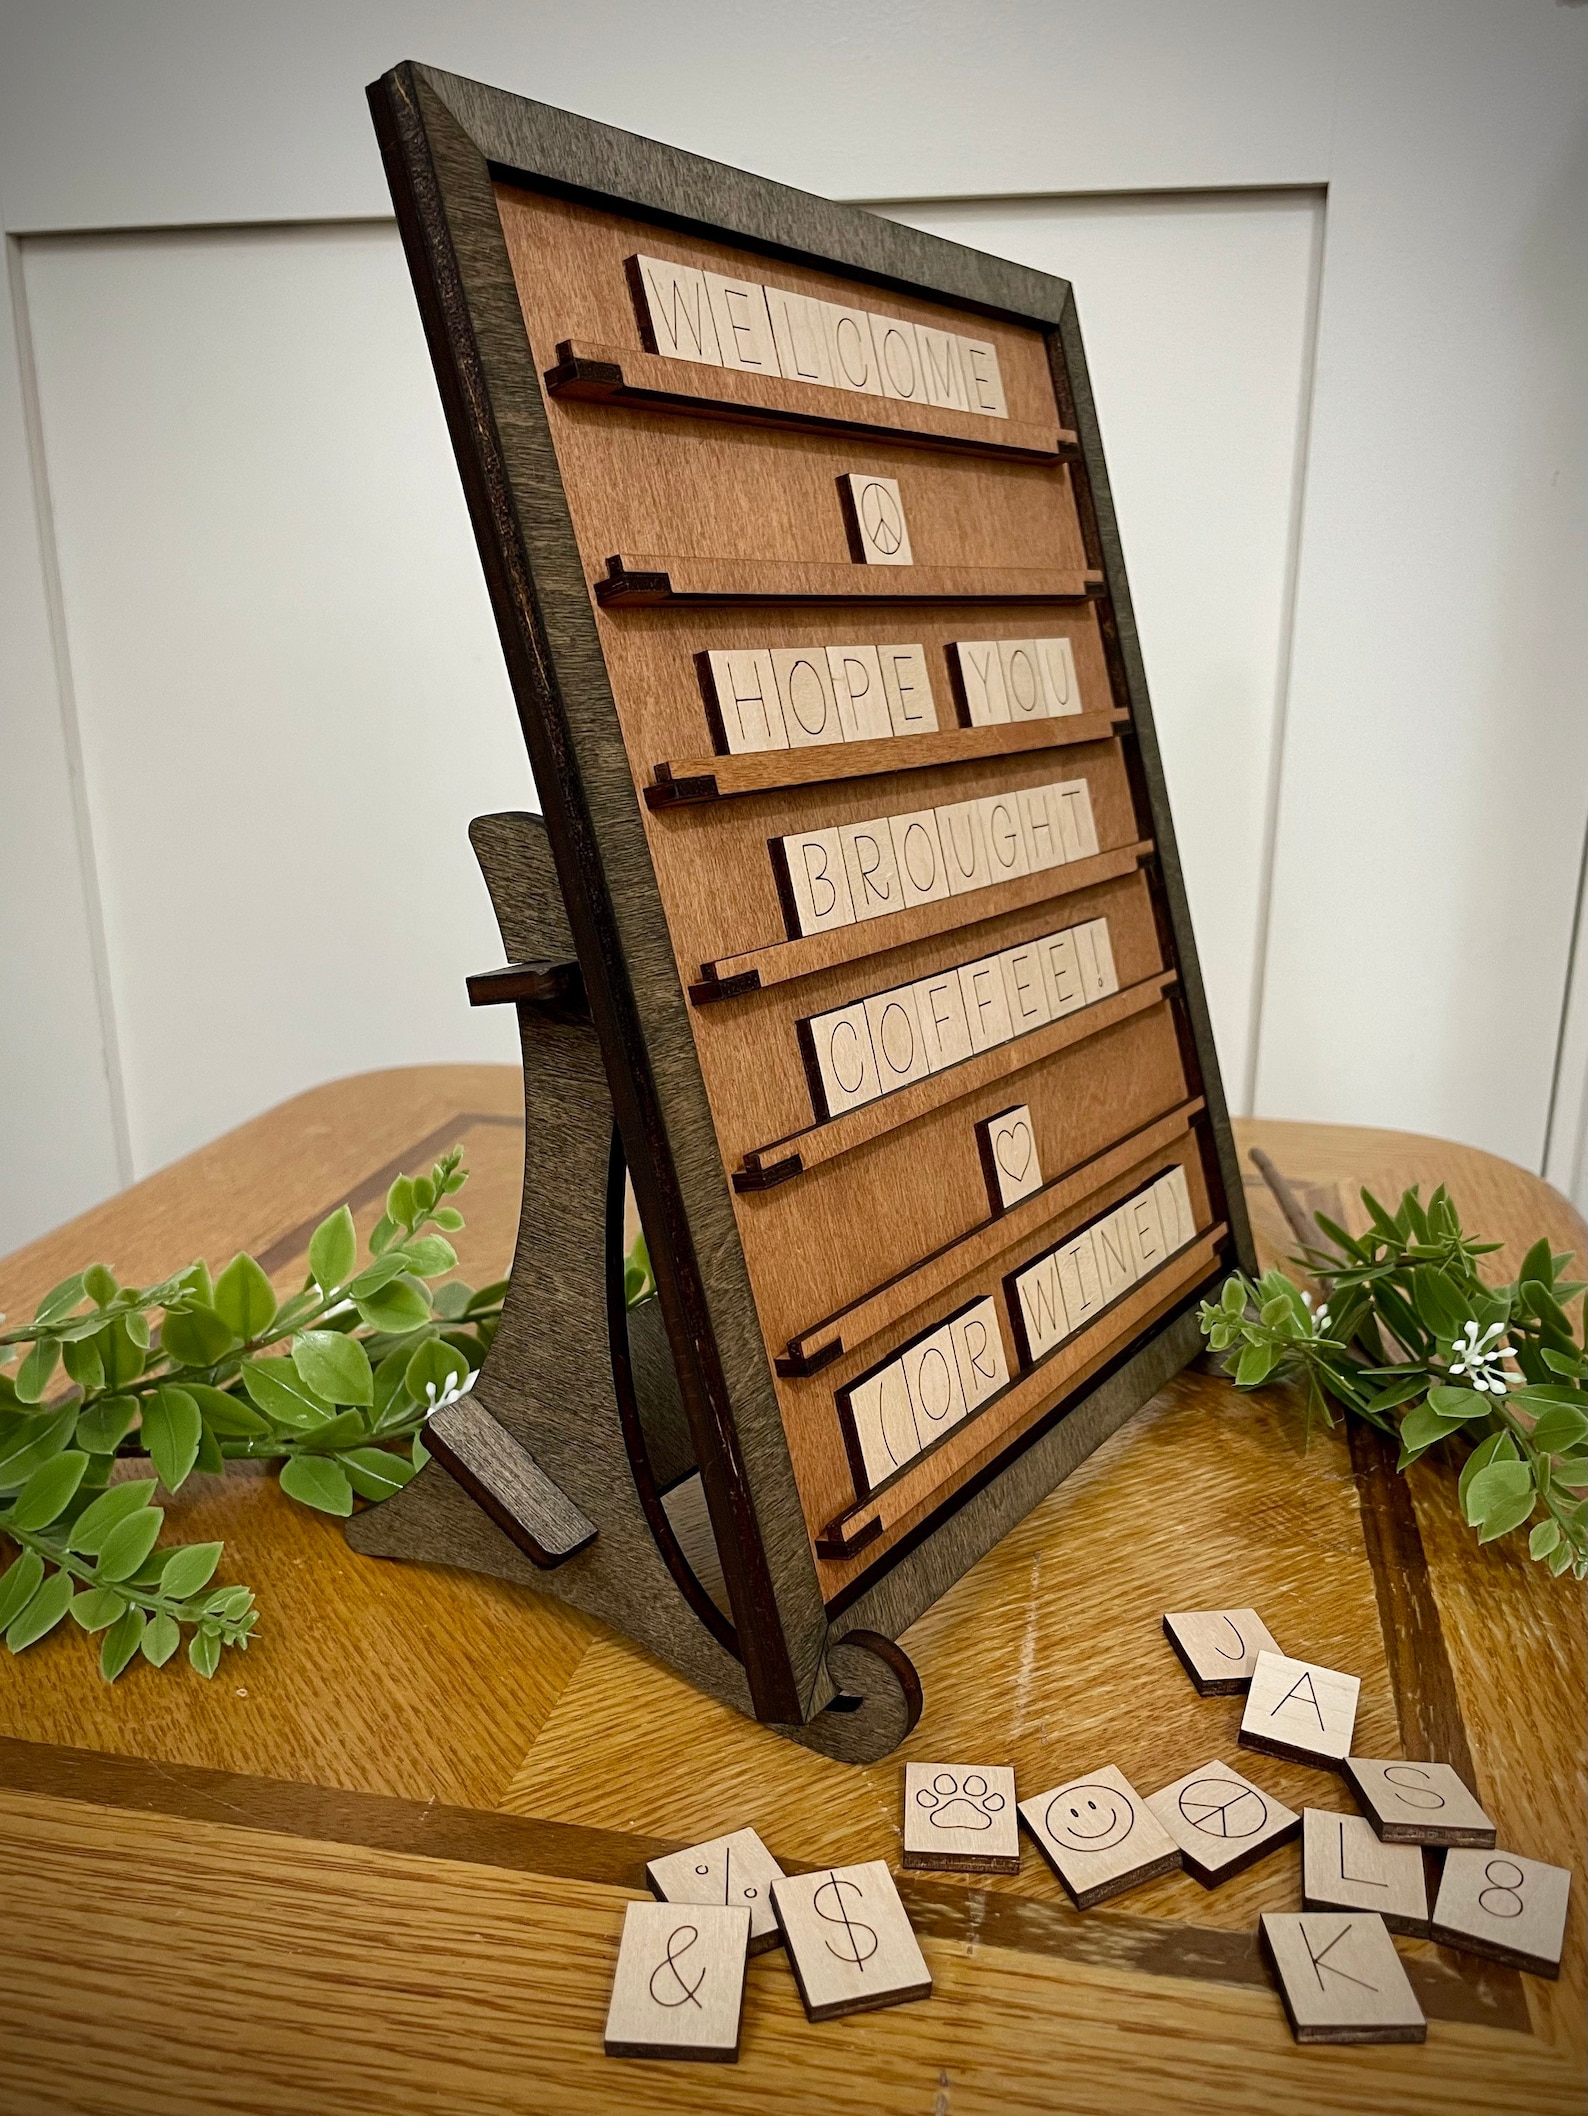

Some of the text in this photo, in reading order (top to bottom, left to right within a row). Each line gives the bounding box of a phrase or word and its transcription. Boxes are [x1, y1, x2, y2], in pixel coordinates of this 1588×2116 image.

[647, 267, 997, 410] WELCOME
[727, 649, 1069, 740] HOPE YOU
[802, 790, 1081, 917] BROUGHT
[830, 927, 1104, 1093] COFFEE!
[879, 1180, 1181, 1467] (OR WINE)
[1214, 1615, 1246, 1661] J
[1270, 1671, 1325, 1732] A
[1383, 1765, 1446, 1810] S
[1339, 1821, 1389, 1888] L
[1478, 1859, 1524, 1918] 8
[813, 1871, 878, 1973] $
[1299, 1920, 1380, 1992] K
[649, 1925, 707, 2009] &
